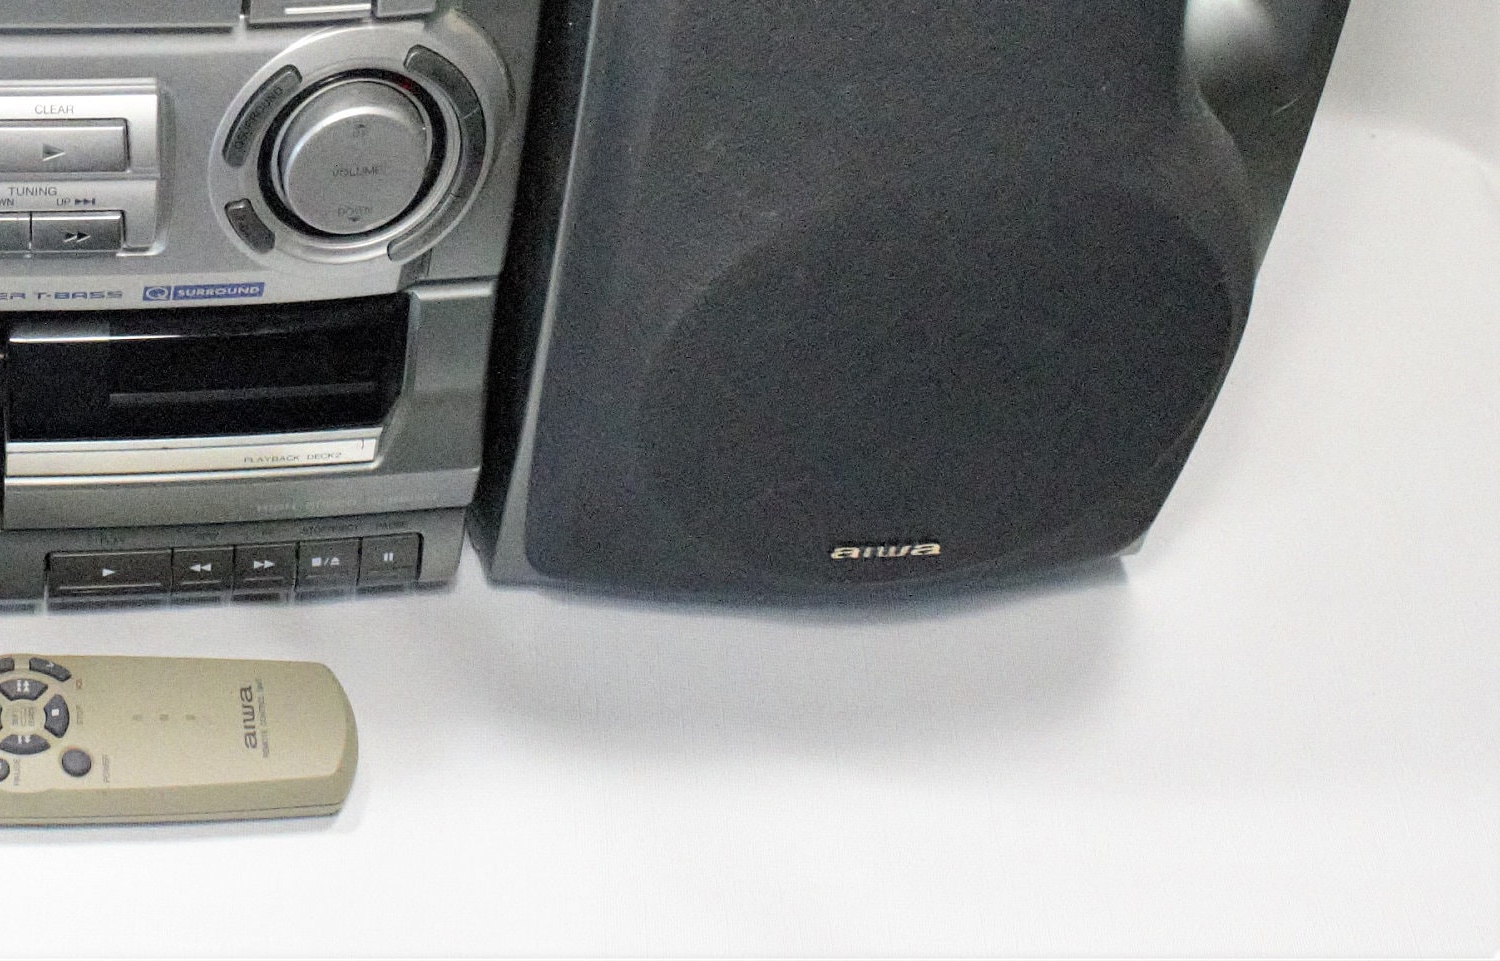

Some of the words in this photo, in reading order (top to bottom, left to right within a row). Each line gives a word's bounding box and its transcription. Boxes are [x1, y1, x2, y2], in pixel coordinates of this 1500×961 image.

[34, 104, 75, 115] CLEAR
[8, 186, 58, 196] TUNING
[56, 197, 71, 207] UP
[36, 290, 123, 301] T-BASS
[177, 285, 259, 298] SURROUND
[243, 455, 300, 464] PLAYBACK
[830, 542, 942, 559] aiwa
[239, 684, 259, 750] aiwa
